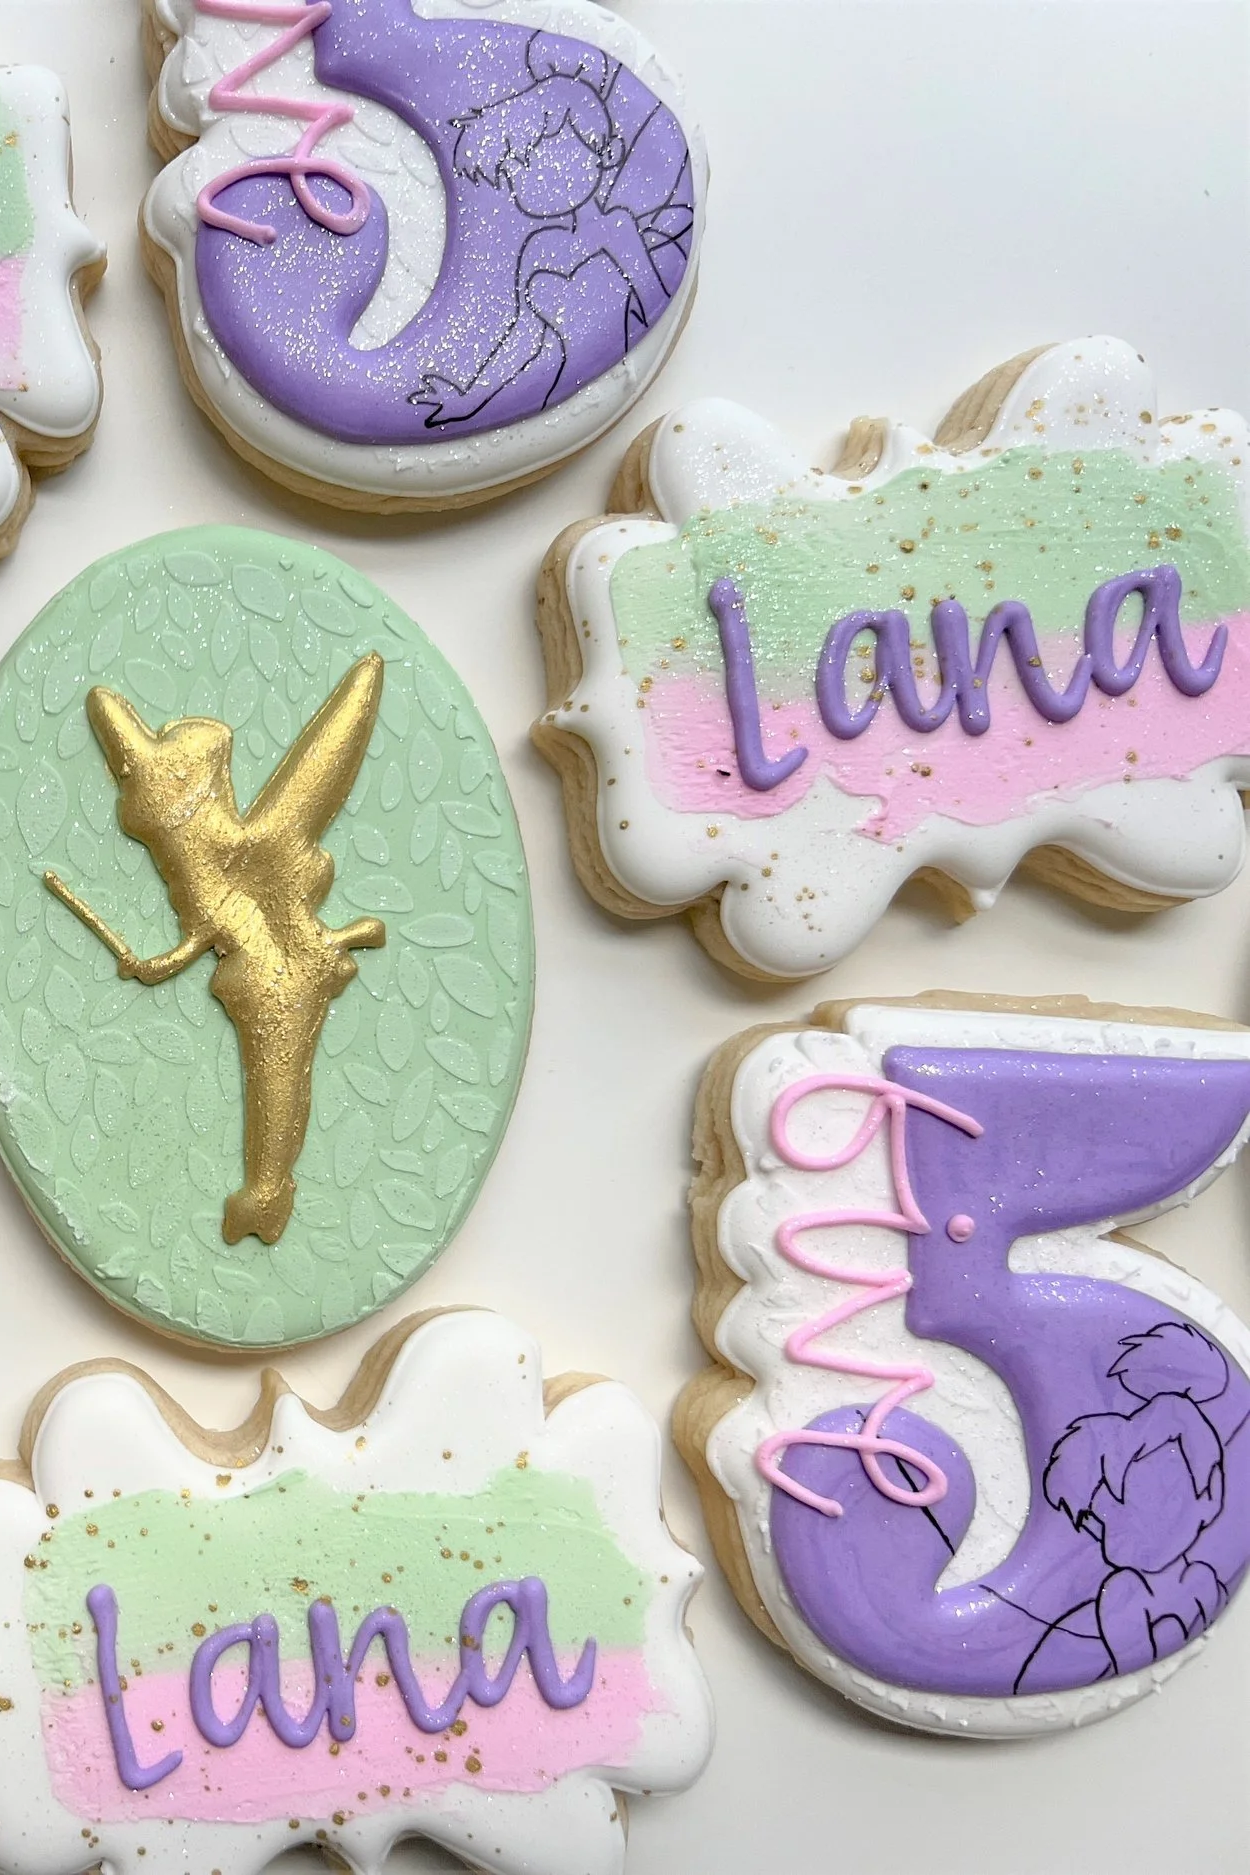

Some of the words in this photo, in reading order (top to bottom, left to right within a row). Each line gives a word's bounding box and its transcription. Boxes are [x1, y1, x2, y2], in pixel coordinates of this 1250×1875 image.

[196, 0, 371, 244] ve
[708, 564, 1229, 792] Lana
[753, 1074, 984, 1518] five
[768, 1045, 1250, 1698] 5
[85, 1576, 597, 1792] Lana
